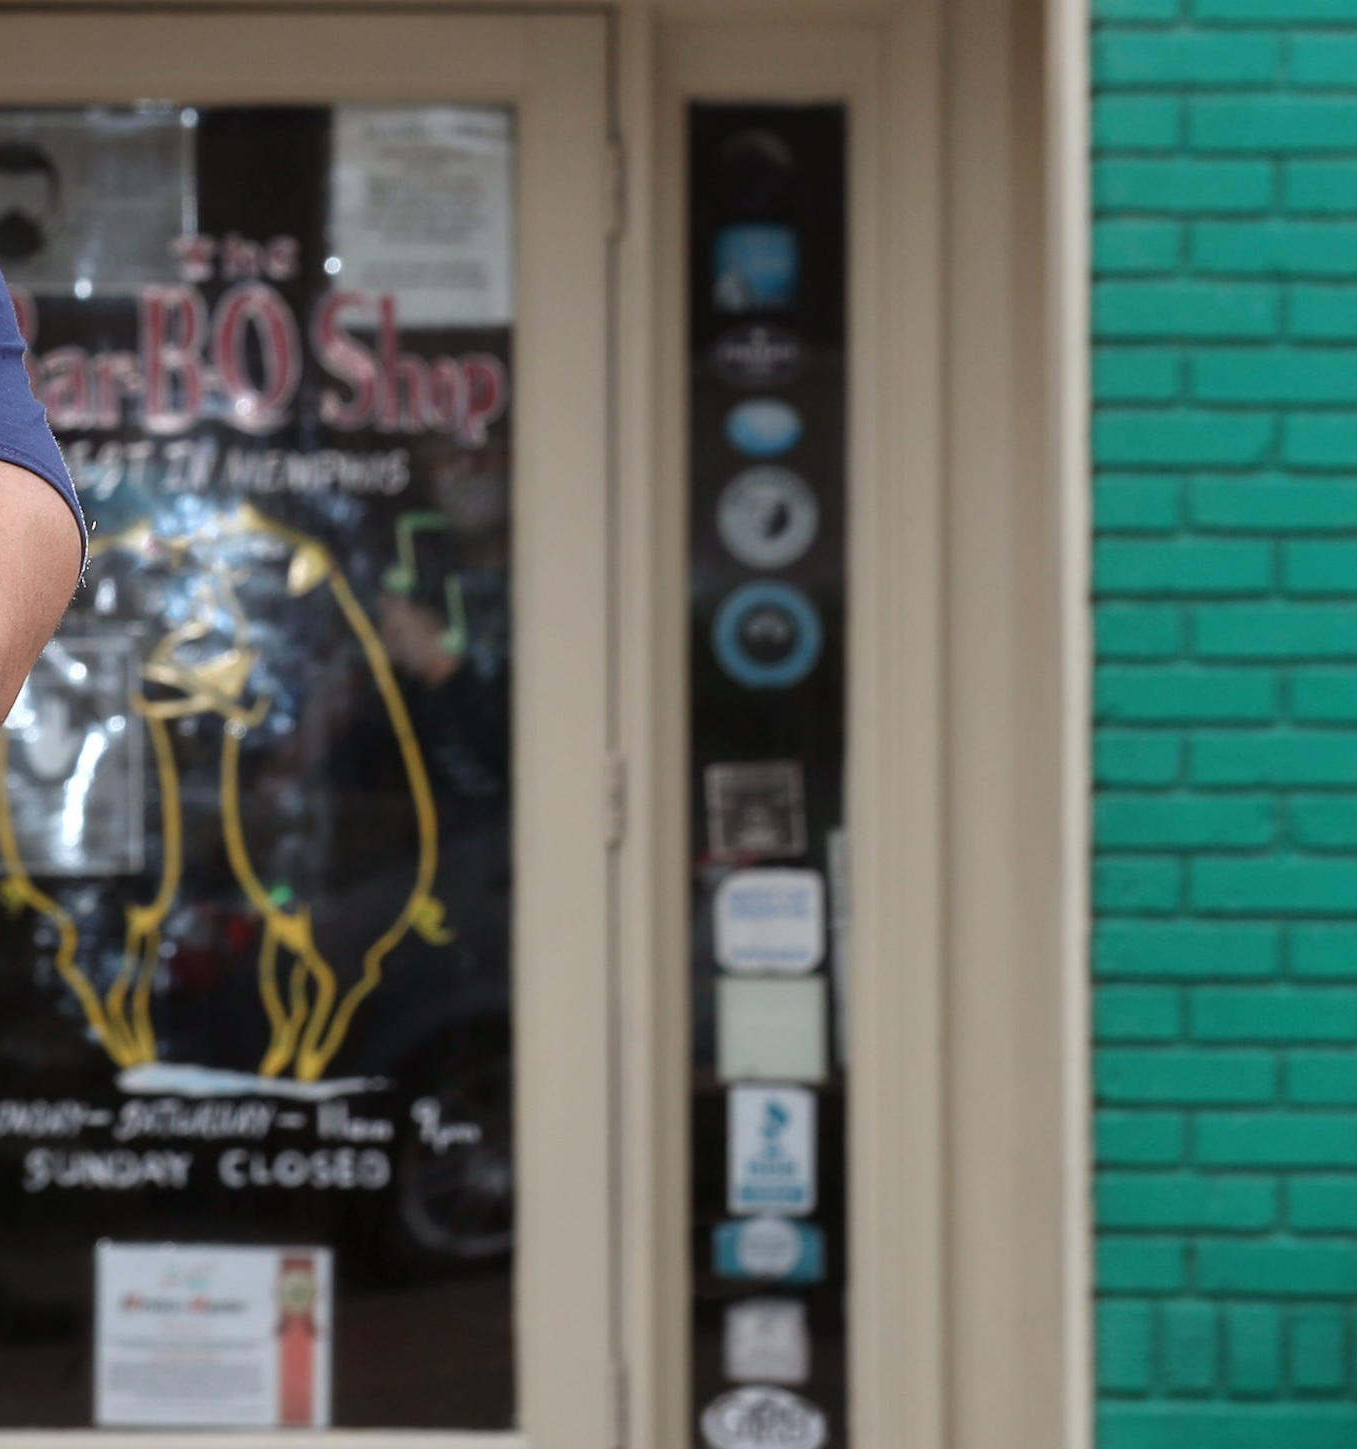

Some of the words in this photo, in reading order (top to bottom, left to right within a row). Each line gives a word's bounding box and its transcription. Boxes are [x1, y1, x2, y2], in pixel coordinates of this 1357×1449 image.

[311, 290, 507, 448] Shop
[22, 1146, 193, 1192] SUNDAY
[216, 1147, 392, 1192] CLOSED
